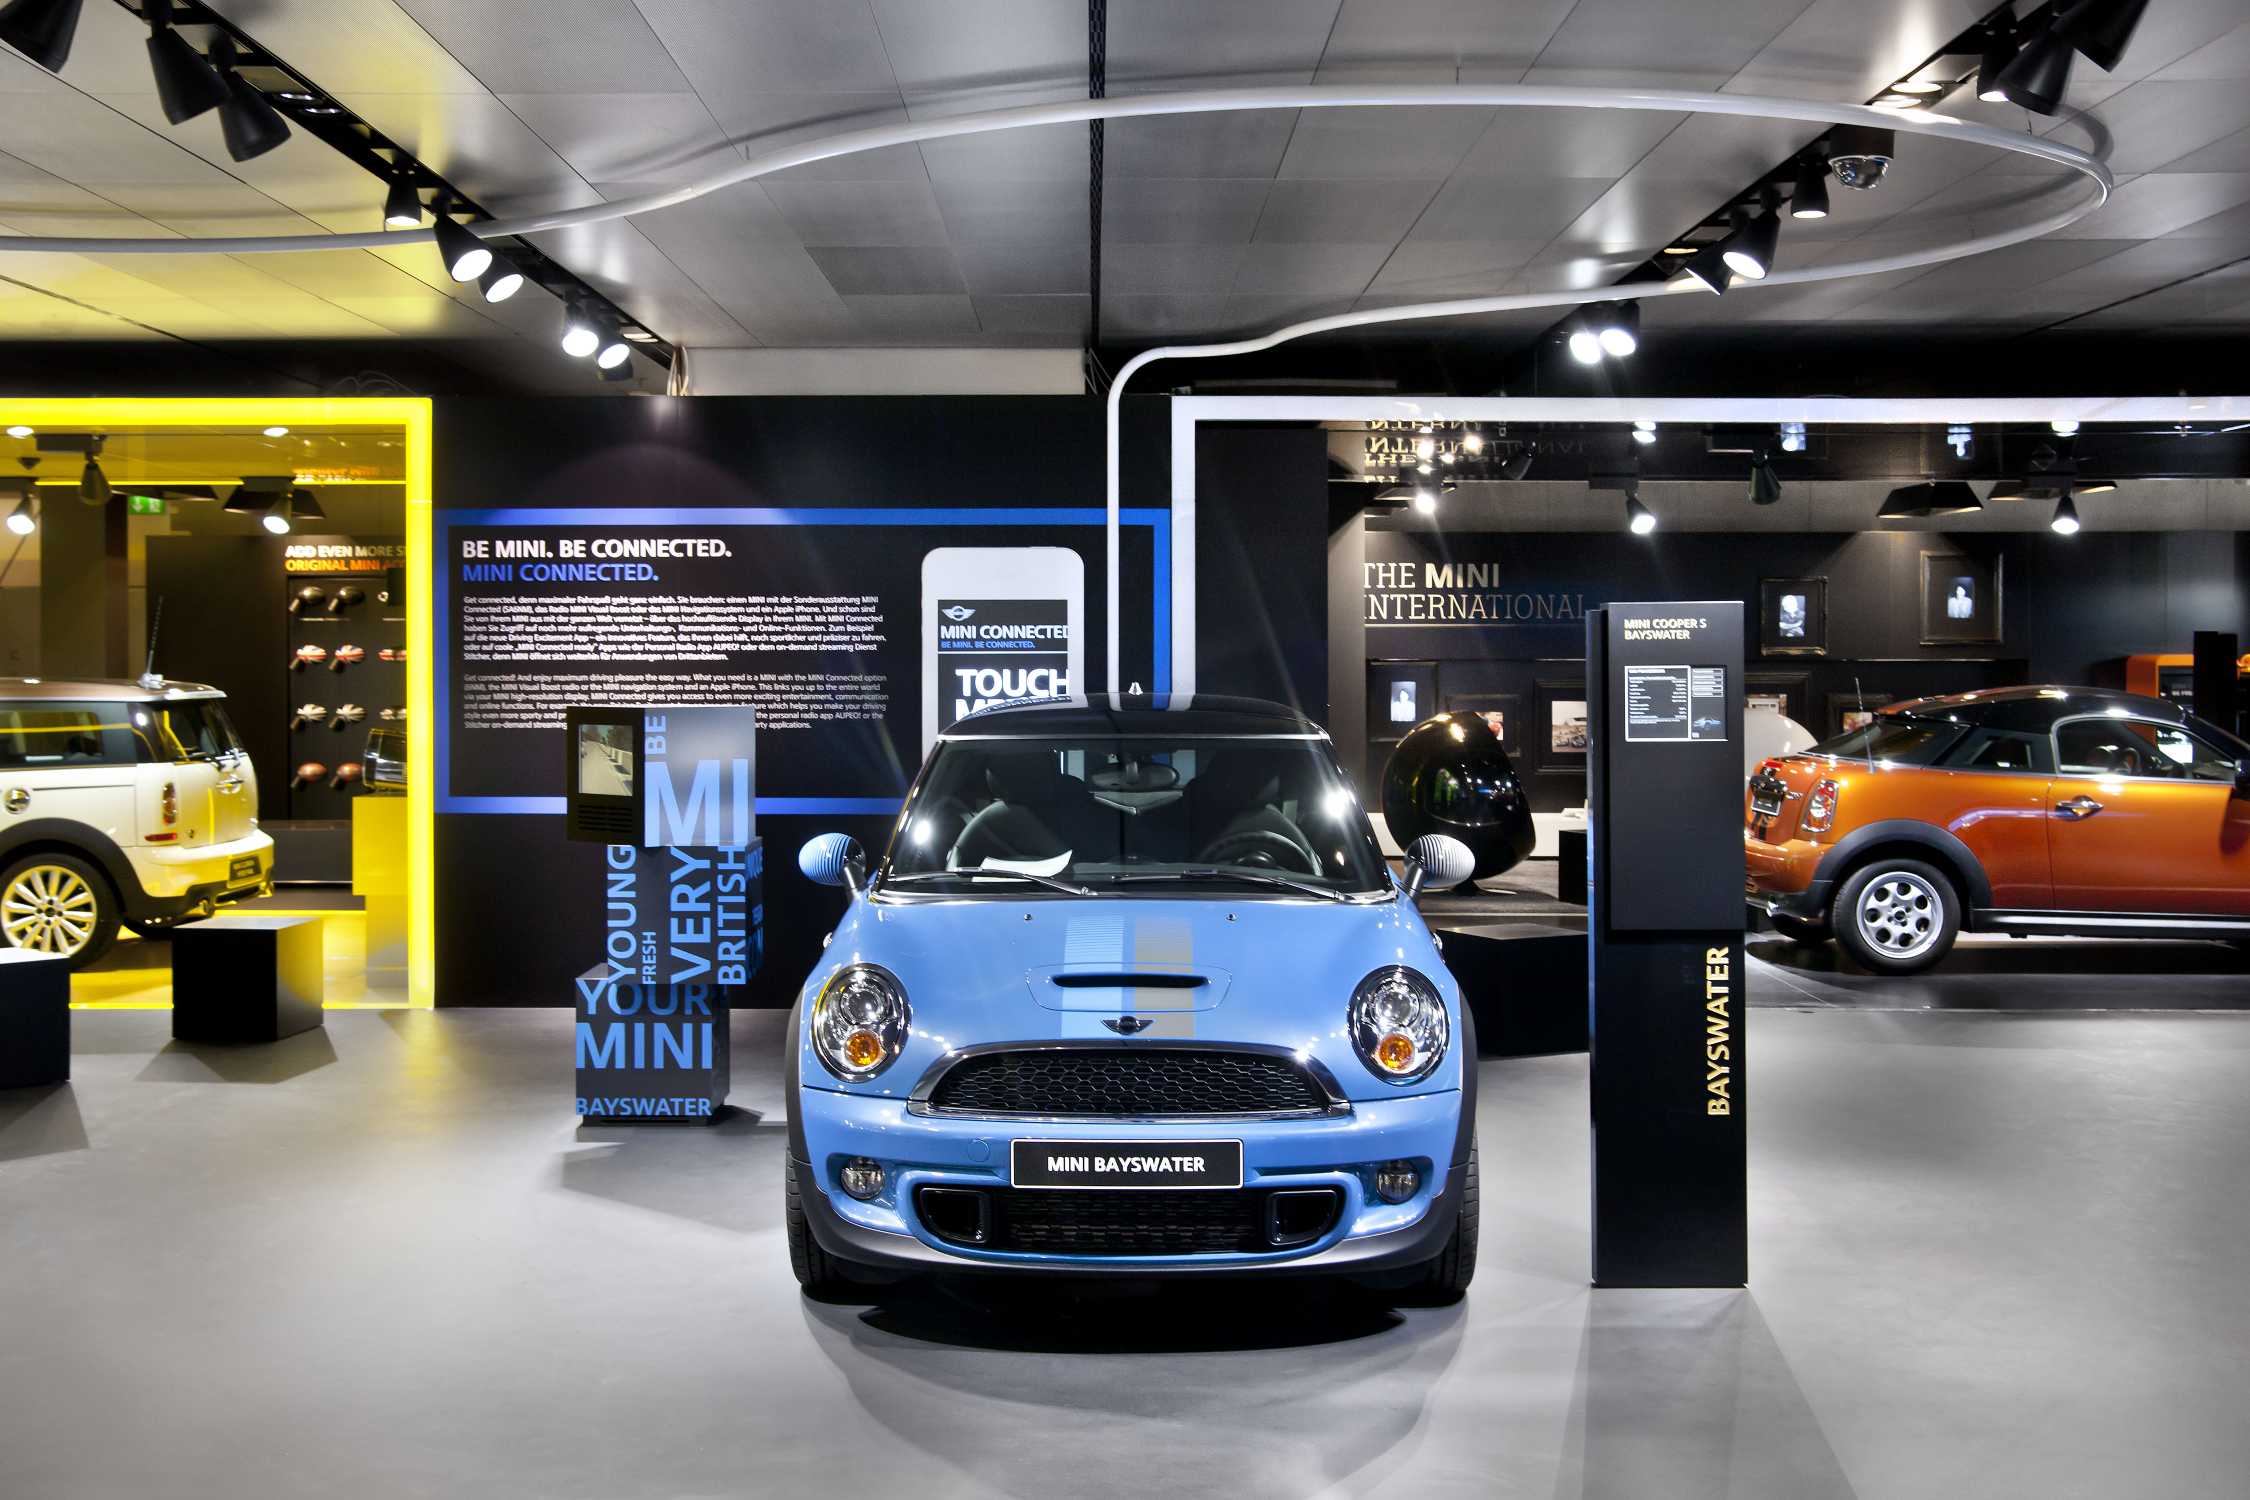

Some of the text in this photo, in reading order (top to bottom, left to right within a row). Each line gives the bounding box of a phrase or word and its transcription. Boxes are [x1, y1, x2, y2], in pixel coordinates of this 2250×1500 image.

[285, 545, 317, 558] ADD
[318, 545, 353, 558] EVEN
[355, 545, 393, 557] MORE
[463, 539, 732, 558] BE MINI. BE CONNECTED.
[285, 559, 349, 571] ORIGINAL
[350, 559, 380, 571] MINI
[463, 562, 659, 581] MINI CONNECTED.
[1363, 562, 1500, 589] THE MINI
[1364, 594, 1585, 620] NTERNATIONAL
[940, 625, 977, 639] MINI
[1624, 618, 1707, 629] MINI COOPER S
[1624, 629, 1691, 640] BAYSWATER
[941, 640, 952, 649] BE
[975, 640, 985, 649] BE
[955, 668, 1070, 698] TOUCH
[645, 715, 667, 755] BE
[644, 758, 749, 848] MI
[607, 845, 637, 984] YOUNG
[670, 846, 712, 985] VERY
[717, 845, 747, 985] BRITISH
[642, 931, 657, 985] FRESH
[576, 979, 713, 1016] YOUR
[1706, 946, 1730, 1116] BAYSWATER
[576, 1022, 713, 1069] MINI
[576, 1097, 713, 1116] BAYSWATER
[1047, 1156, 1206, 1173] MINI BAYSWATER
